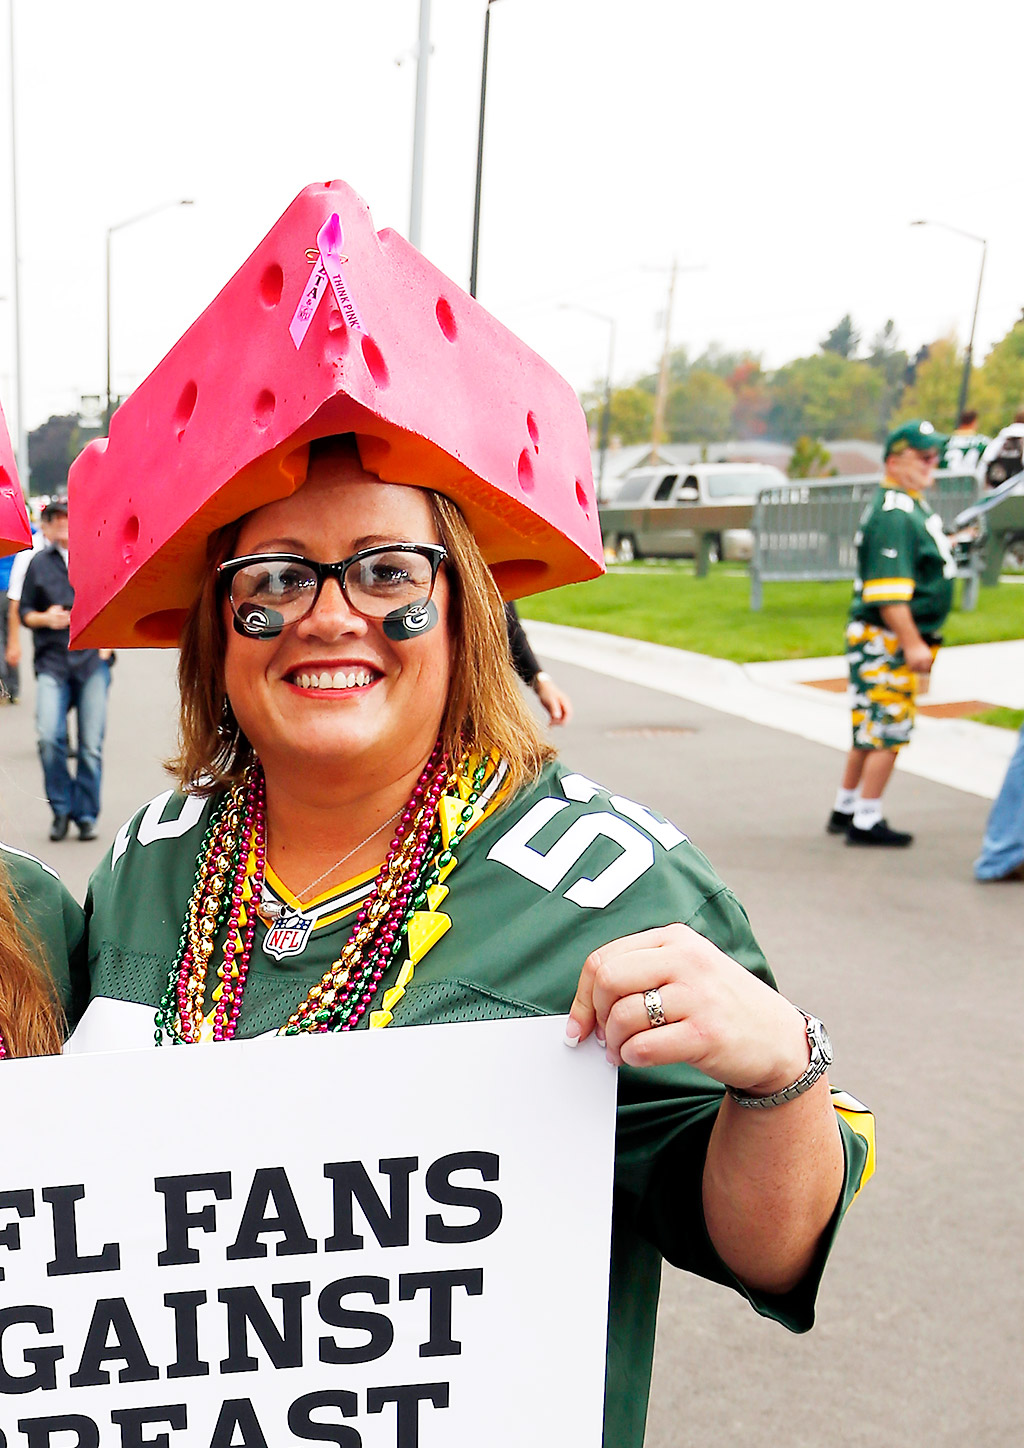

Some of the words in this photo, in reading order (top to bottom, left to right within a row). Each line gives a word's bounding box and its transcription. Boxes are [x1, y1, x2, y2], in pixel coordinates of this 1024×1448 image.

[333, 273, 350, 304] THINK
[486, 772, 692, 909] 52
[269, 930, 299, 950] NFL
[154, 1151, 502, 1266] FANS
